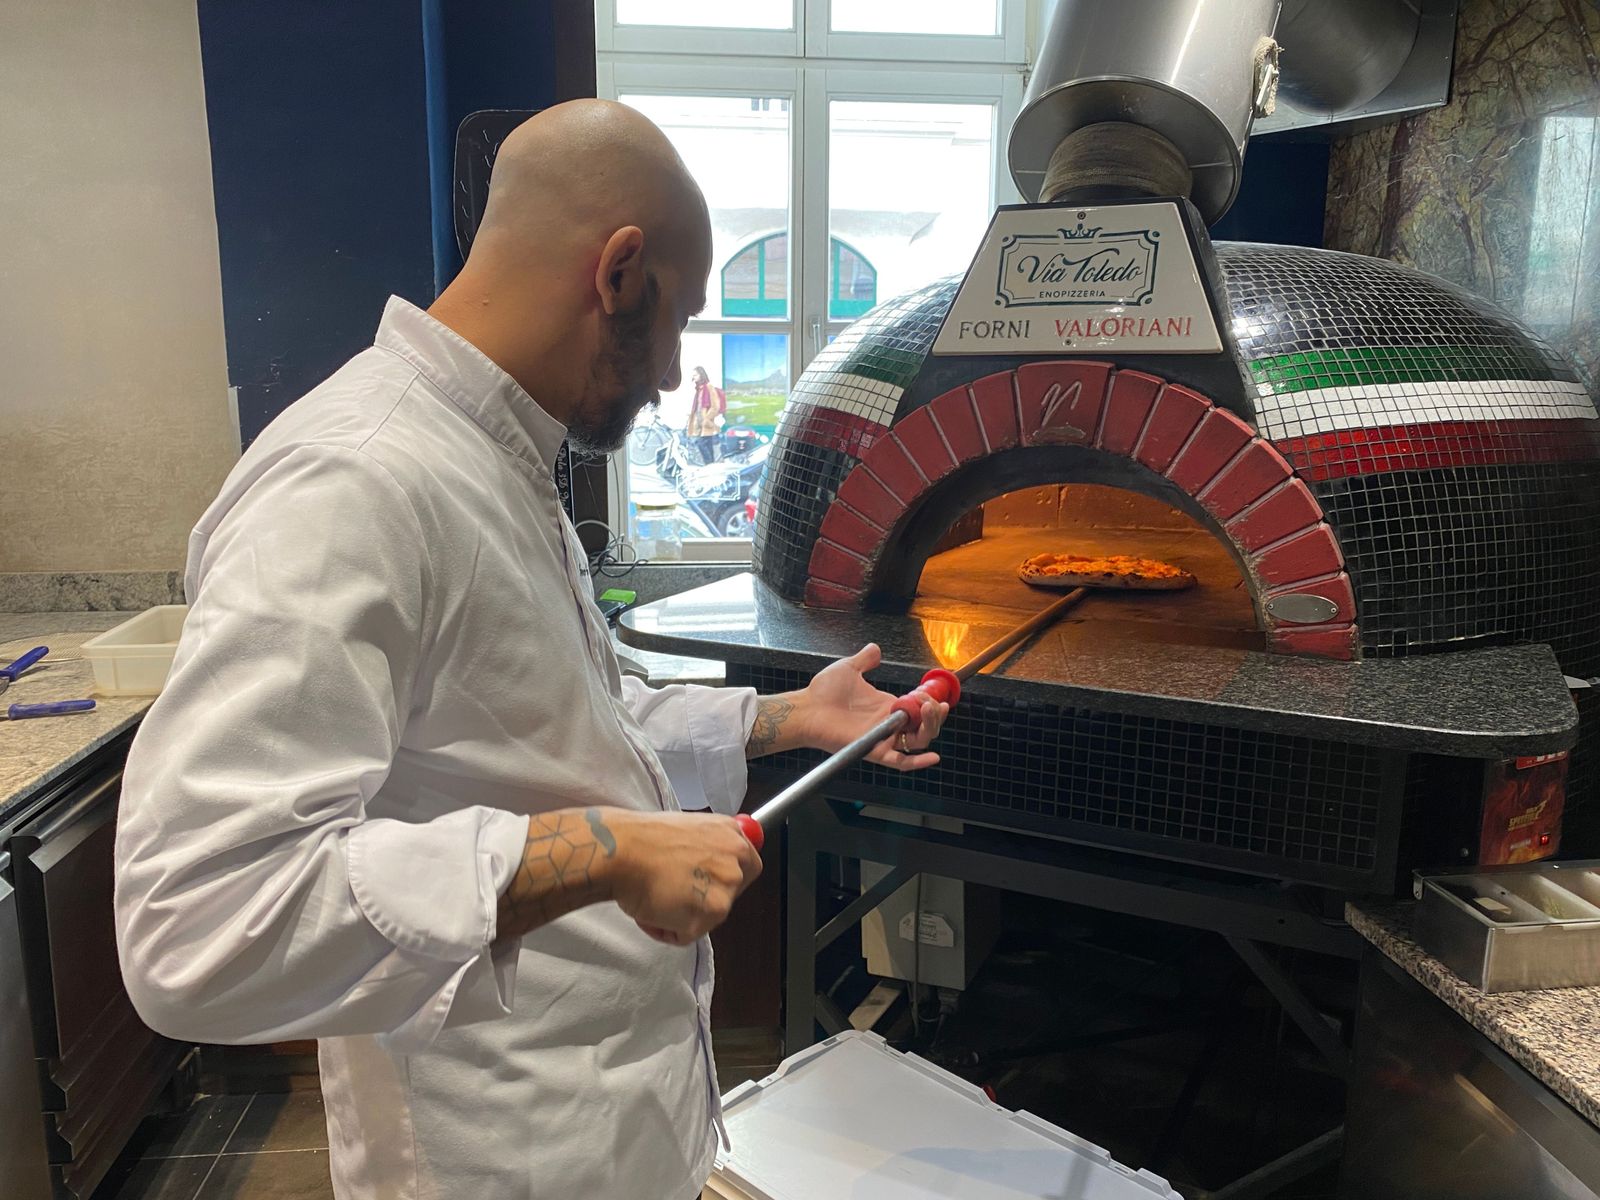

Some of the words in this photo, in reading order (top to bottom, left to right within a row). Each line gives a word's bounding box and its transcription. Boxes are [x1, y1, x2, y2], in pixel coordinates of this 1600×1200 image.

[1017, 253, 1067, 283] Via
[1062, 247, 1143, 283] Toledo
[1039, 290, 1106, 298] ENOPIZZERIA
[959, 320, 1030, 340] FORNI
[1054, 317, 1192, 337] VALORIANI
